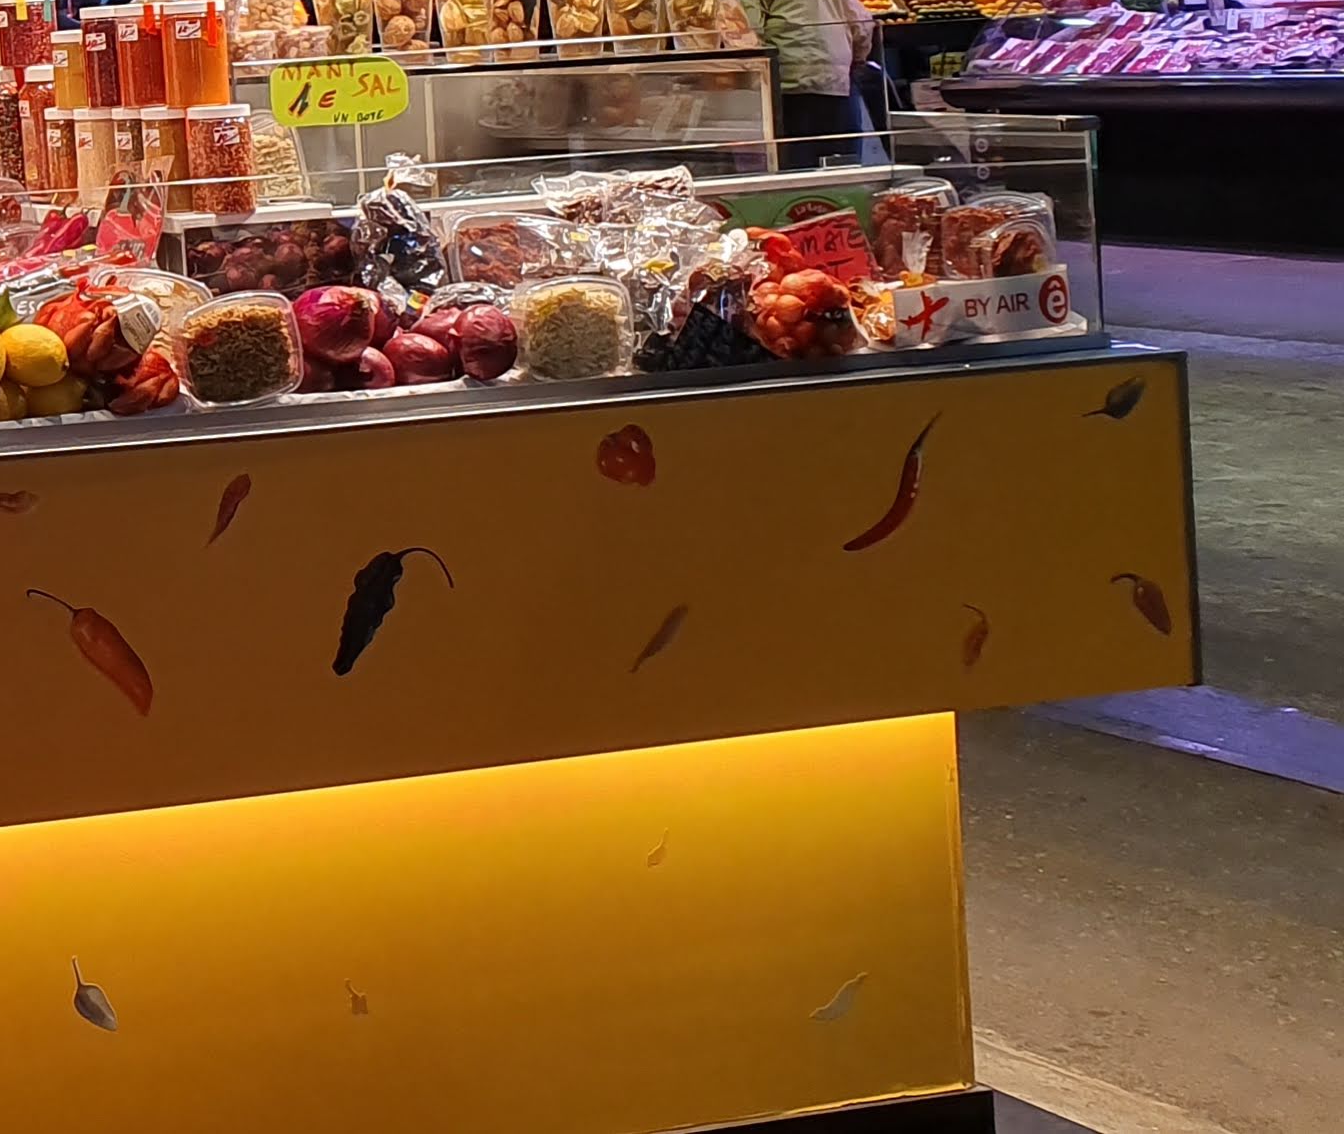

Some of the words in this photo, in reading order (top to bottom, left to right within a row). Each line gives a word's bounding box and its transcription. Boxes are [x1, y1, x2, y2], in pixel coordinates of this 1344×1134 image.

[351, 72, 401, 97] SAL
[964, 296, 990, 317] BY
[996, 292, 1030, 315] AIR
